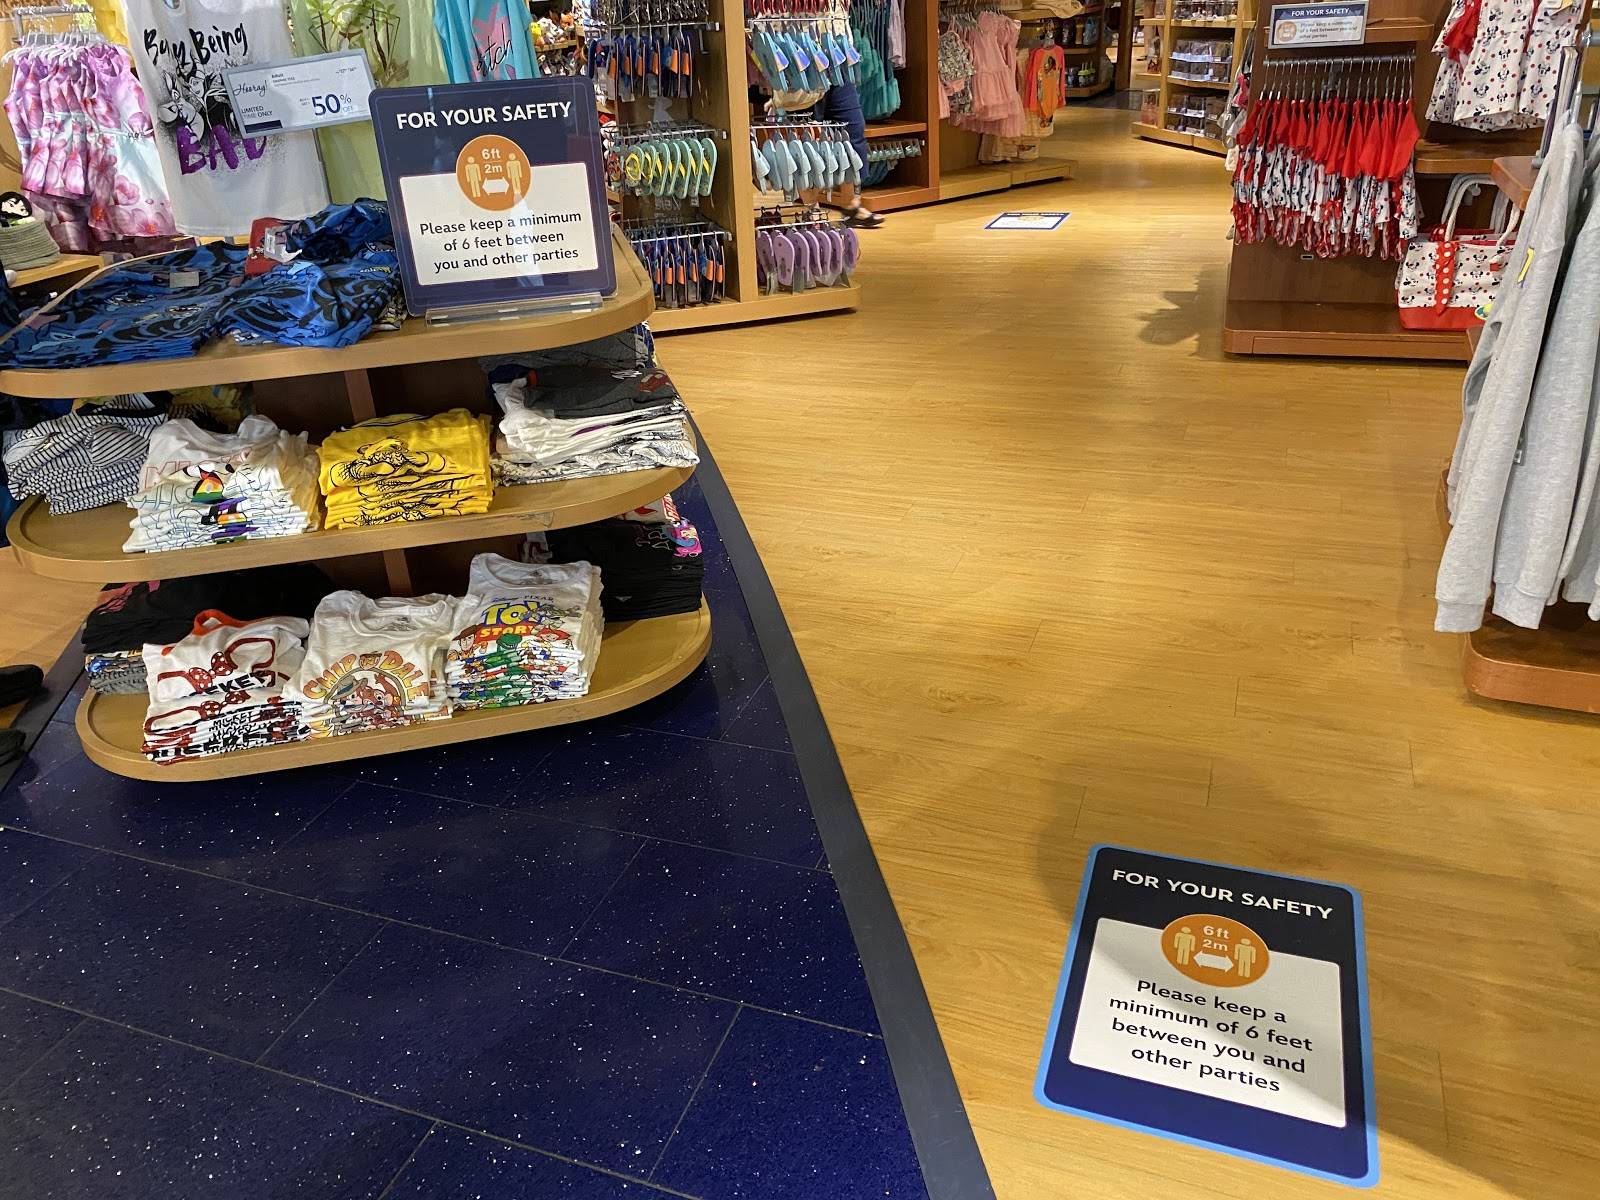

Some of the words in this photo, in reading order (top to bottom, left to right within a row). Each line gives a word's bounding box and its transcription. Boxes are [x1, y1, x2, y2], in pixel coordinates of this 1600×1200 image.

[188, 23, 249, 65] Being
[241, 105, 264, 114] LIMITED
[257, 110, 273, 118] ONLY
[397, 111, 438, 130] FOR
[441, 107, 498, 127] YOUR
[502, 101, 572, 122] SAFETY
[481, 148, 501, 160] 6ft
[484, 164, 503, 174] 2m
[419, 222, 467, 236] Please
[469, 219, 504, 233] keep
[507, 218, 516, 228] a
[519, 212, 582, 226] minimum
[444, 239, 458, 252] of
[462, 238, 471, 250] 6
[474, 236, 503, 249] feet
[505, 231, 565, 246] between
[434, 260, 460, 274] you
[463, 255, 488, 268] and
[492, 252, 529, 266] other
[532, 248, 579, 265] parties
[302, 653, 357, 700] CHIP
[379, 650, 431, 700] DALE
[1112, 869, 1160, 889] FOR
[1167, 879, 1234, 903] YOUR
[1241, 893, 1334, 920] SAFETY
[1202, 939, 1229, 952] 2m
[1203, 925, 1230, 940] 6ft
[1137, 979, 1207, 1006] Please
[1214, 996, 1266, 1020] keep
[1274, 1011, 1287, 1023] a
[1109, 998, 1208, 1028] minimum
[1216, 1021, 1239, 1035] of
[1246, 1025, 1259, 1039] 6
[1266, 1030, 1313, 1051] feet
[1111, 1017, 1207, 1050] between
[1213, 1043, 1255, 1061] you
[1263, 1053, 1306, 1073] and
[1131, 1048, 1192, 1070] other
[1199, 1063, 1280, 1092] parties
